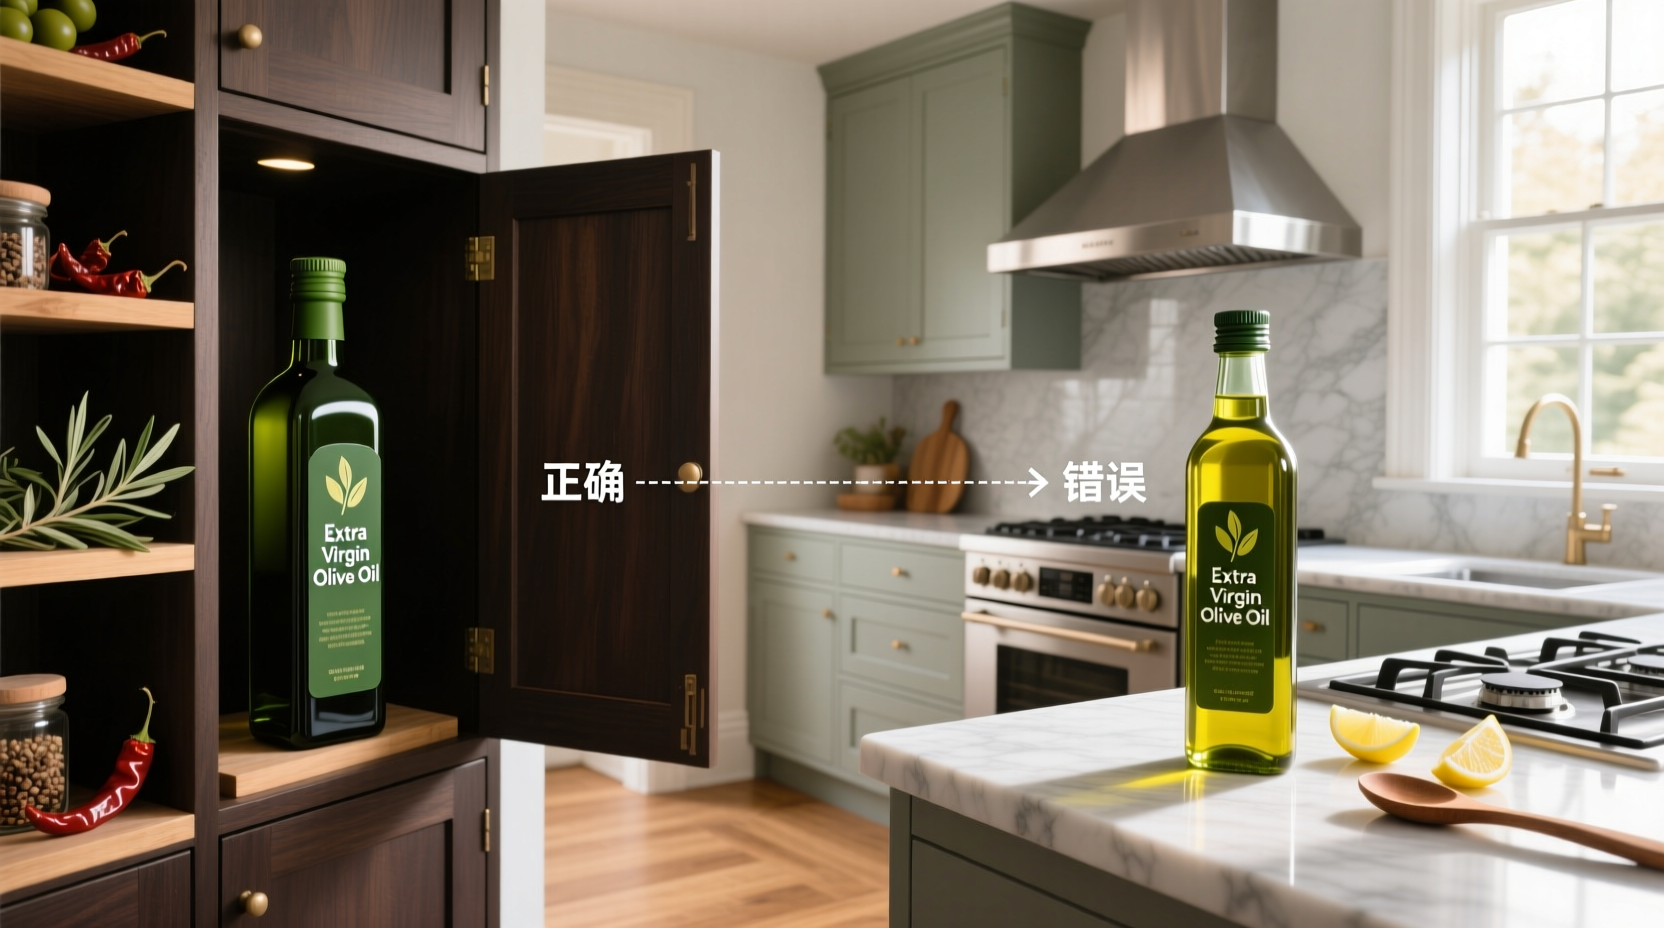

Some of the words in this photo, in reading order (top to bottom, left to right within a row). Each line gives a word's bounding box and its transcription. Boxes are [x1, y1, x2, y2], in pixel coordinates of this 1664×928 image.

[324, 523, 367, 542] Extra
[321, 545, 370, 567] Virgin
[313, 567, 355, 586] Olive
[358, 563, 380, 583] Oil
[1211, 566, 1257, 584] Extra
[1209, 587, 1262, 609] Virgin
[1200, 606, 1242, 625] Olive
[1245, 608, 1270, 626] Oil
